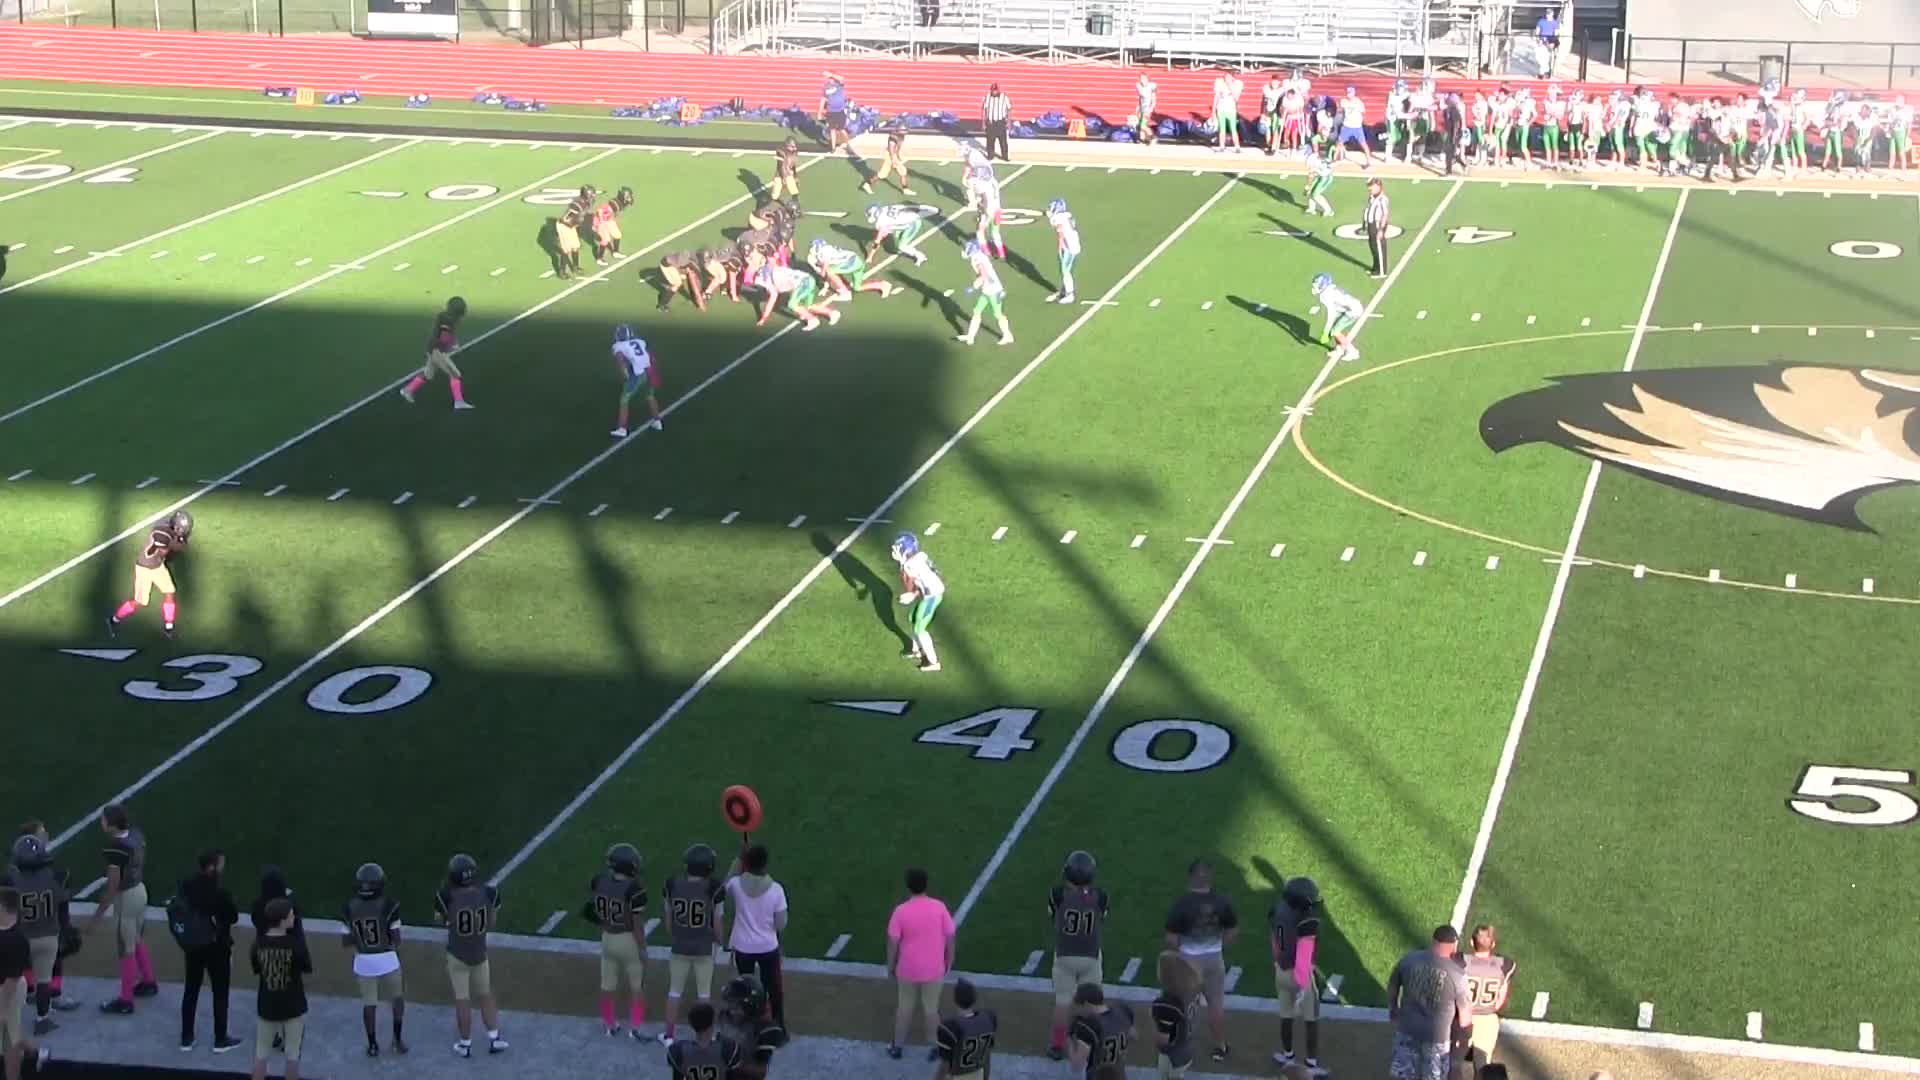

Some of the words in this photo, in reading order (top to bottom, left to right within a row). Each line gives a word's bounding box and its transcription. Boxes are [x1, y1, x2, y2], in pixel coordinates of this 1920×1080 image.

[683, 104, 698, 119] 20
[629, 340, 645, 357] 3
[1788, 764, 1920, 827] 5
[20, 889, 55, 922] 51
[457, 905, 487, 936] 81
[671, 897, 706, 929] 26
[352, 916, 382, 948] 13
[1063, 908, 1095, 936] 31
[959, 1031, 995, 1069] 27
